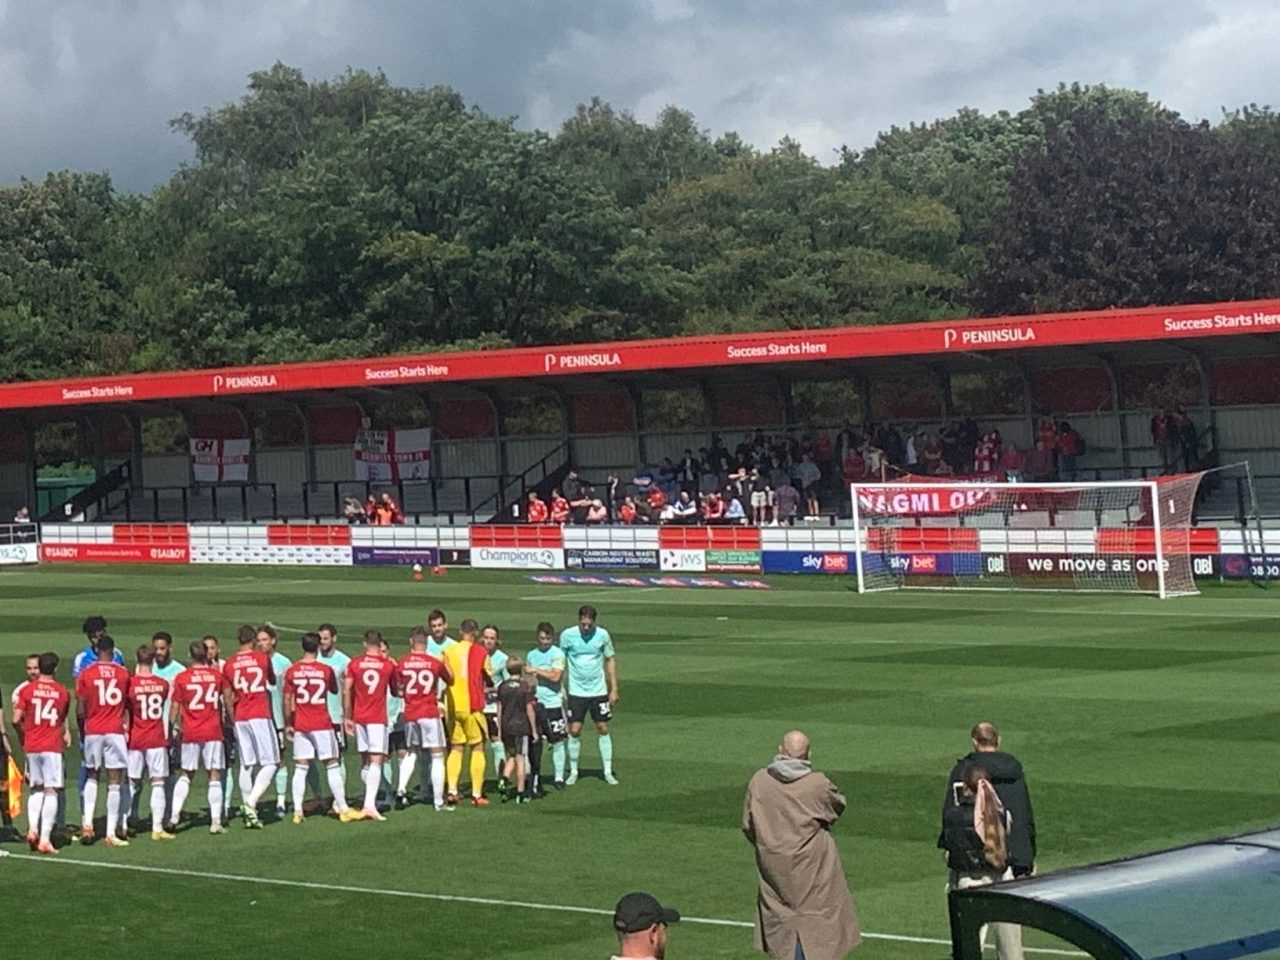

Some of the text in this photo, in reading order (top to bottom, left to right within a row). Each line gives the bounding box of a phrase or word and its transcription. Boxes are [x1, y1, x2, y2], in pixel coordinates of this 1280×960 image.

[1164, 319, 1214, 330] Success
[1215, 315, 1252, 327] Starts
[962, 328, 1035, 344] PENINSULA
[727, 342, 827, 357] Success Starts Here
[560, 353, 620, 368] PENINSULA
[366, 365, 448, 379] Success Starts Here
[226, 375, 276, 388] PENINSULA
[63, 386, 133, 399] Success Starts Here
[52, 548, 78, 557] SALBOY
[157, 549, 185, 558] SALBOY
[480, 549, 538, 564] Champions
[680, 553, 702, 566] JWS
[802, 555, 845, 570] sky bet
[890, 555, 935, 570] sky bet
[1028, 558, 1053, 571] we
[1059, 558, 1106, 571] move
[1112, 558, 1131, 571] as
[233, 667, 265, 694] 42
[363, 669, 380, 695] 9
[402, 669, 434, 694] 29
[93, 679, 122, 706] 16
[186, 683, 219, 710] 24
[293, 678, 326, 704] 32
[31, 698, 58, 727] 14
[136, 693, 163, 720] 18
[551, 720, 565, 733] 25
